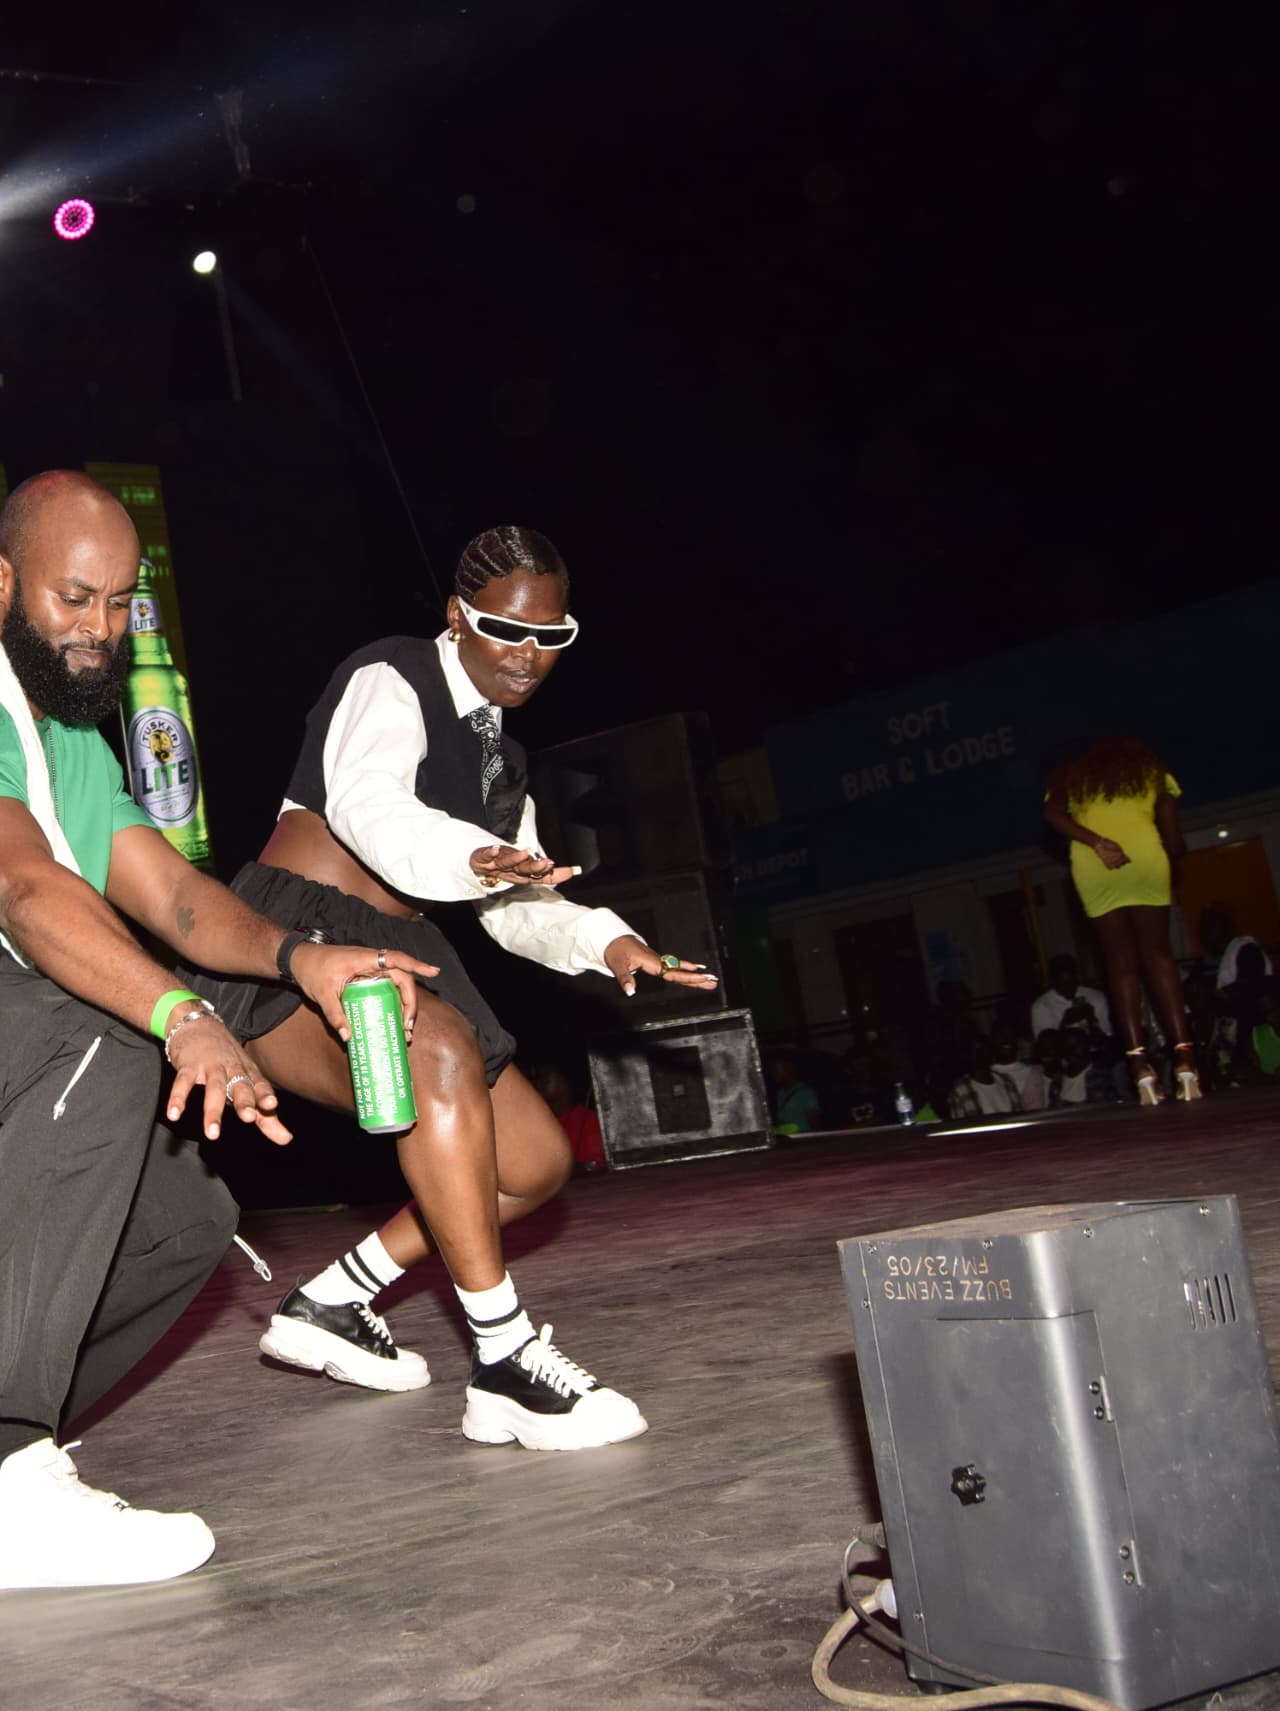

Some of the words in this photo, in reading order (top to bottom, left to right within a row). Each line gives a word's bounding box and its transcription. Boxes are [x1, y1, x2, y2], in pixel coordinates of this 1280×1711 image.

[134, 617, 157, 630] LITE
[142, 721, 178, 742] TUSKER
[887, 701, 952, 744] SOFT
[840, 763, 891, 801] BAR
[898, 756, 915, 784] &
[925, 725, 1016, 776] LODGE
[141, 759, 189, 795] LITE
[352, 1002, 363, 1039] EXCESSIVE
[362, 1076, 370, 1086] OF
[394, 1055, 404, 1086] OPERATE
[364, 1087, 372, 1102] AGE
[398, 1087, 406, 1098] OR
[366, 1103, 374, 1117] THE
[887, 1256, 990, 1277] FM/23/05
[883, 1279, 955, 1300] EVENTS
[960, 1278, 1013, 1302] BUZZ
